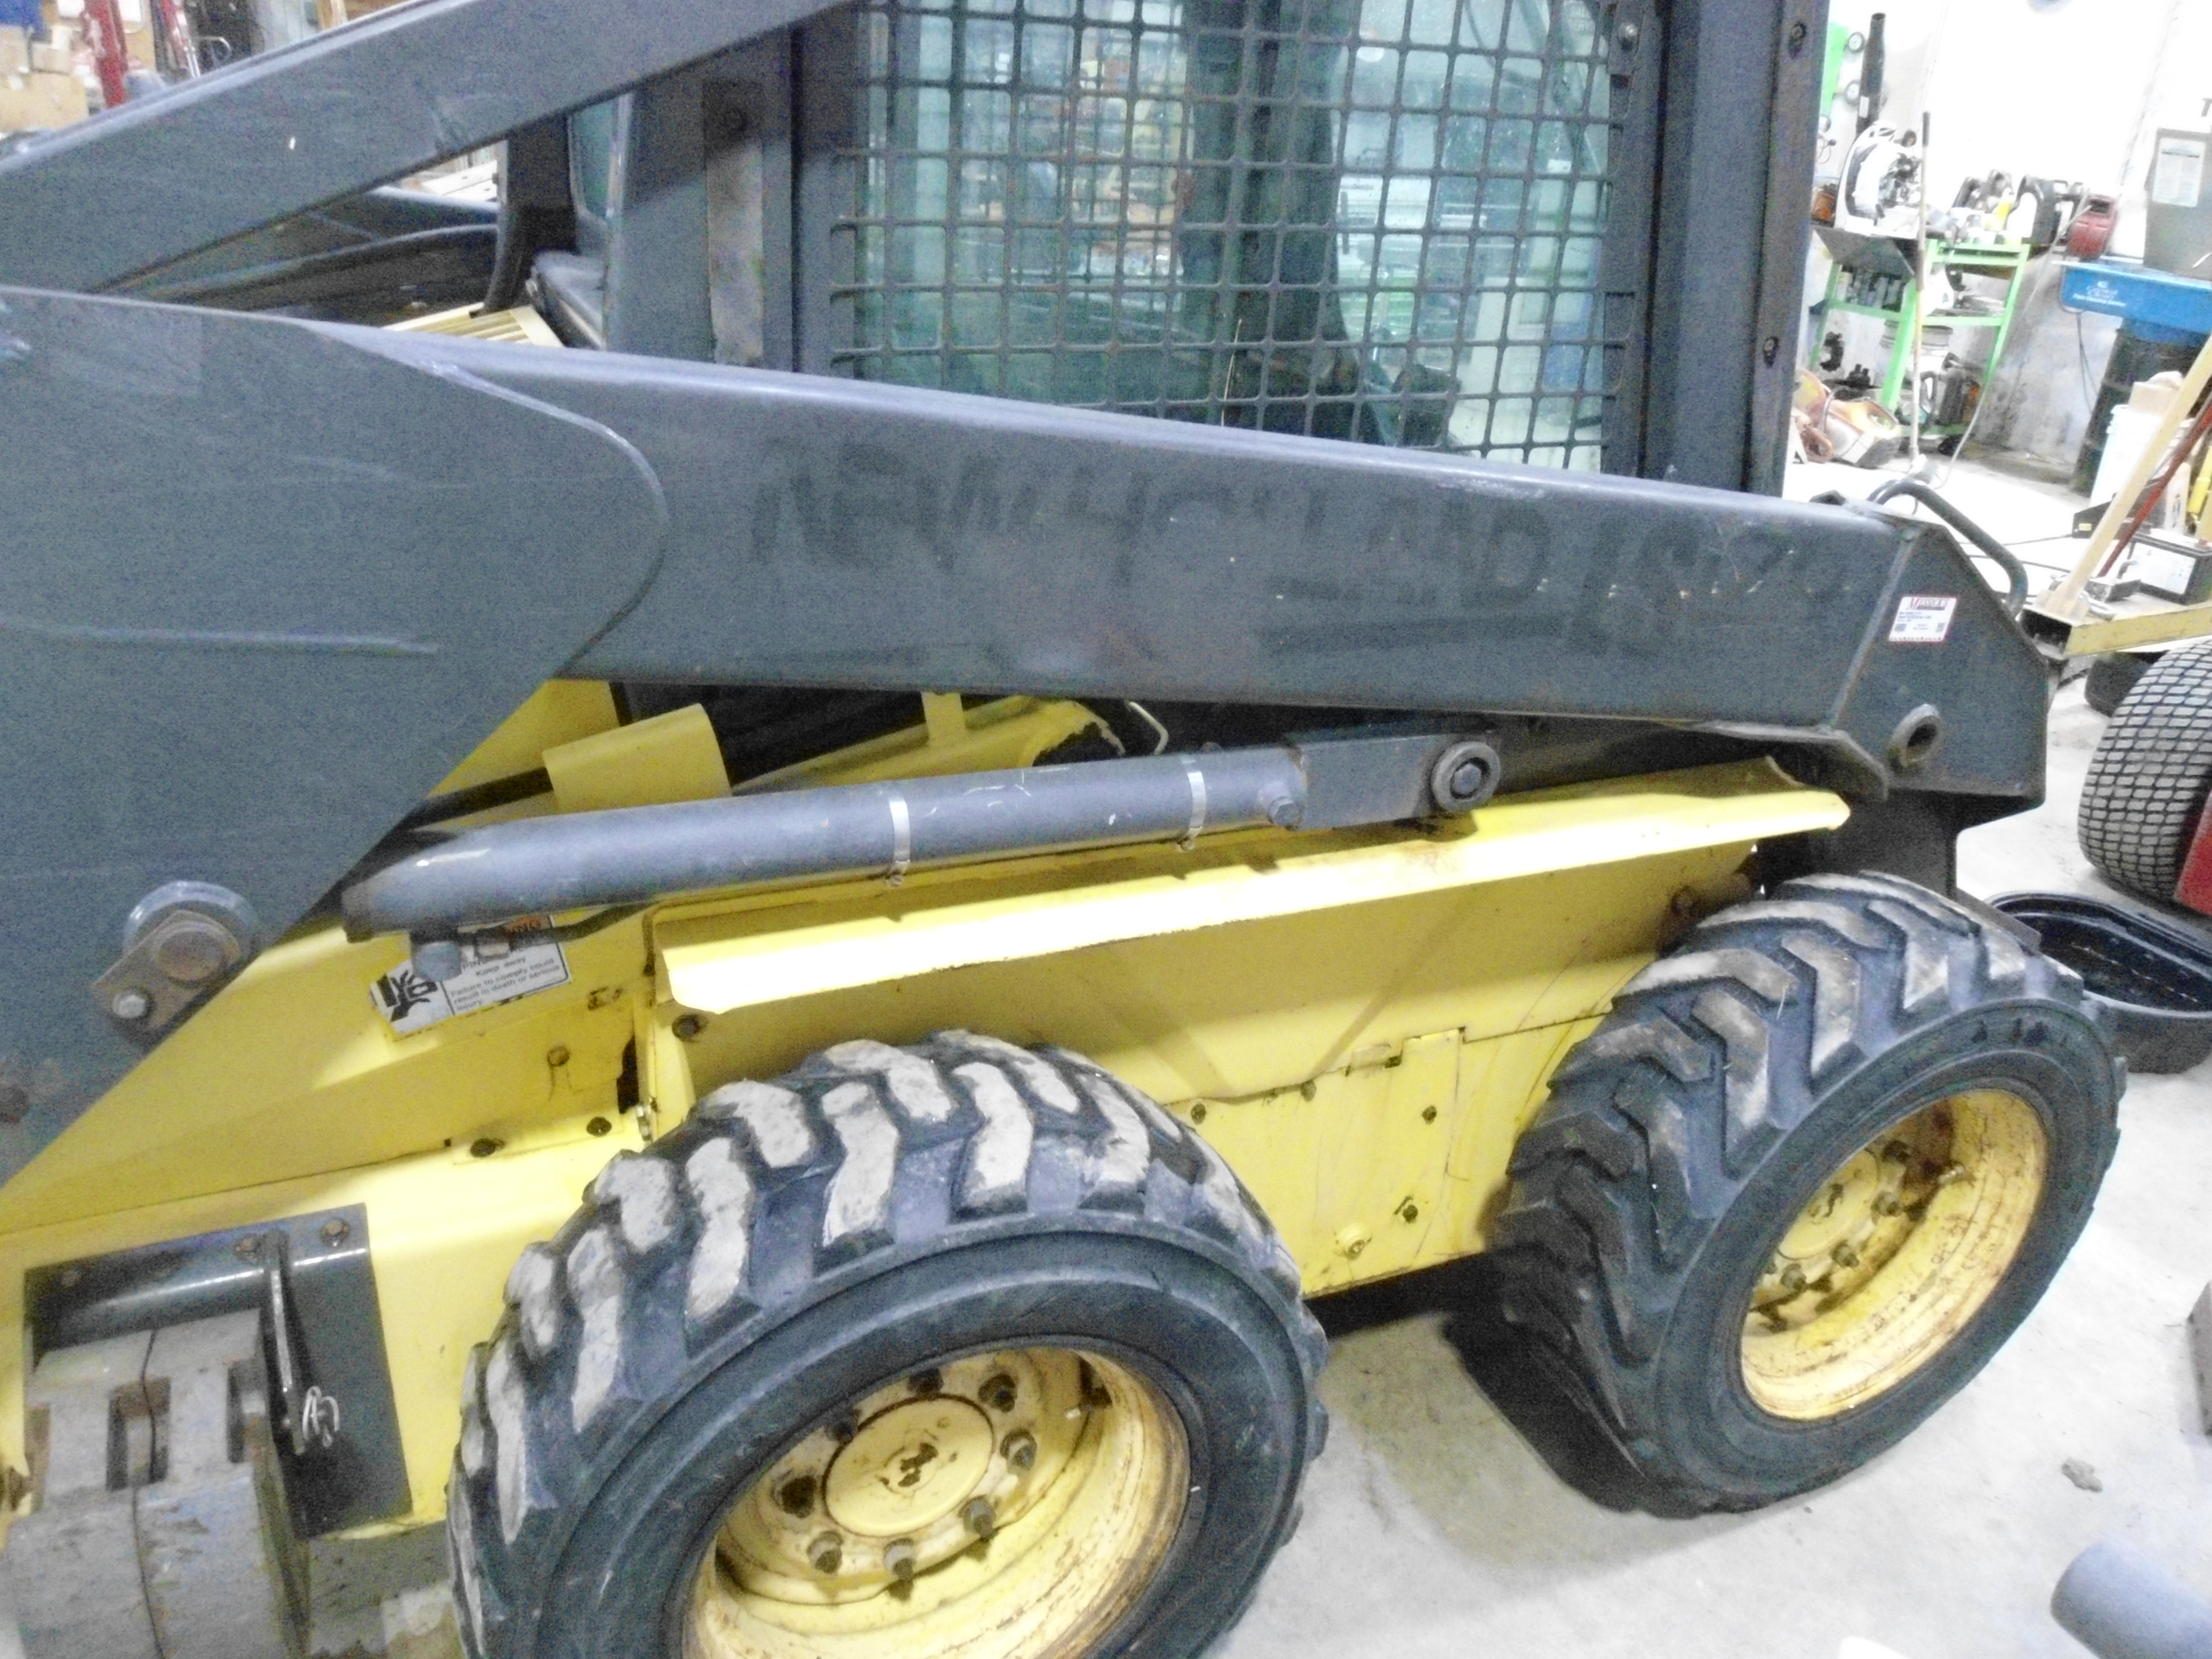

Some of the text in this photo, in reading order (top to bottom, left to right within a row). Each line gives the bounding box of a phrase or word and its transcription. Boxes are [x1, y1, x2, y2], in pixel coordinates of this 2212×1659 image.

[451, 983, 482, 997] Failure
[495, 968, 527, 982] comply
[530, 958, 554, 971] could
[476, 957, 526, 976] Keep away
[454, 991, 479, 1004] result
[491, 979, 516, 992] death
[529, 964, 560, 979] serious
[457, 999, 482, 1011] injury
